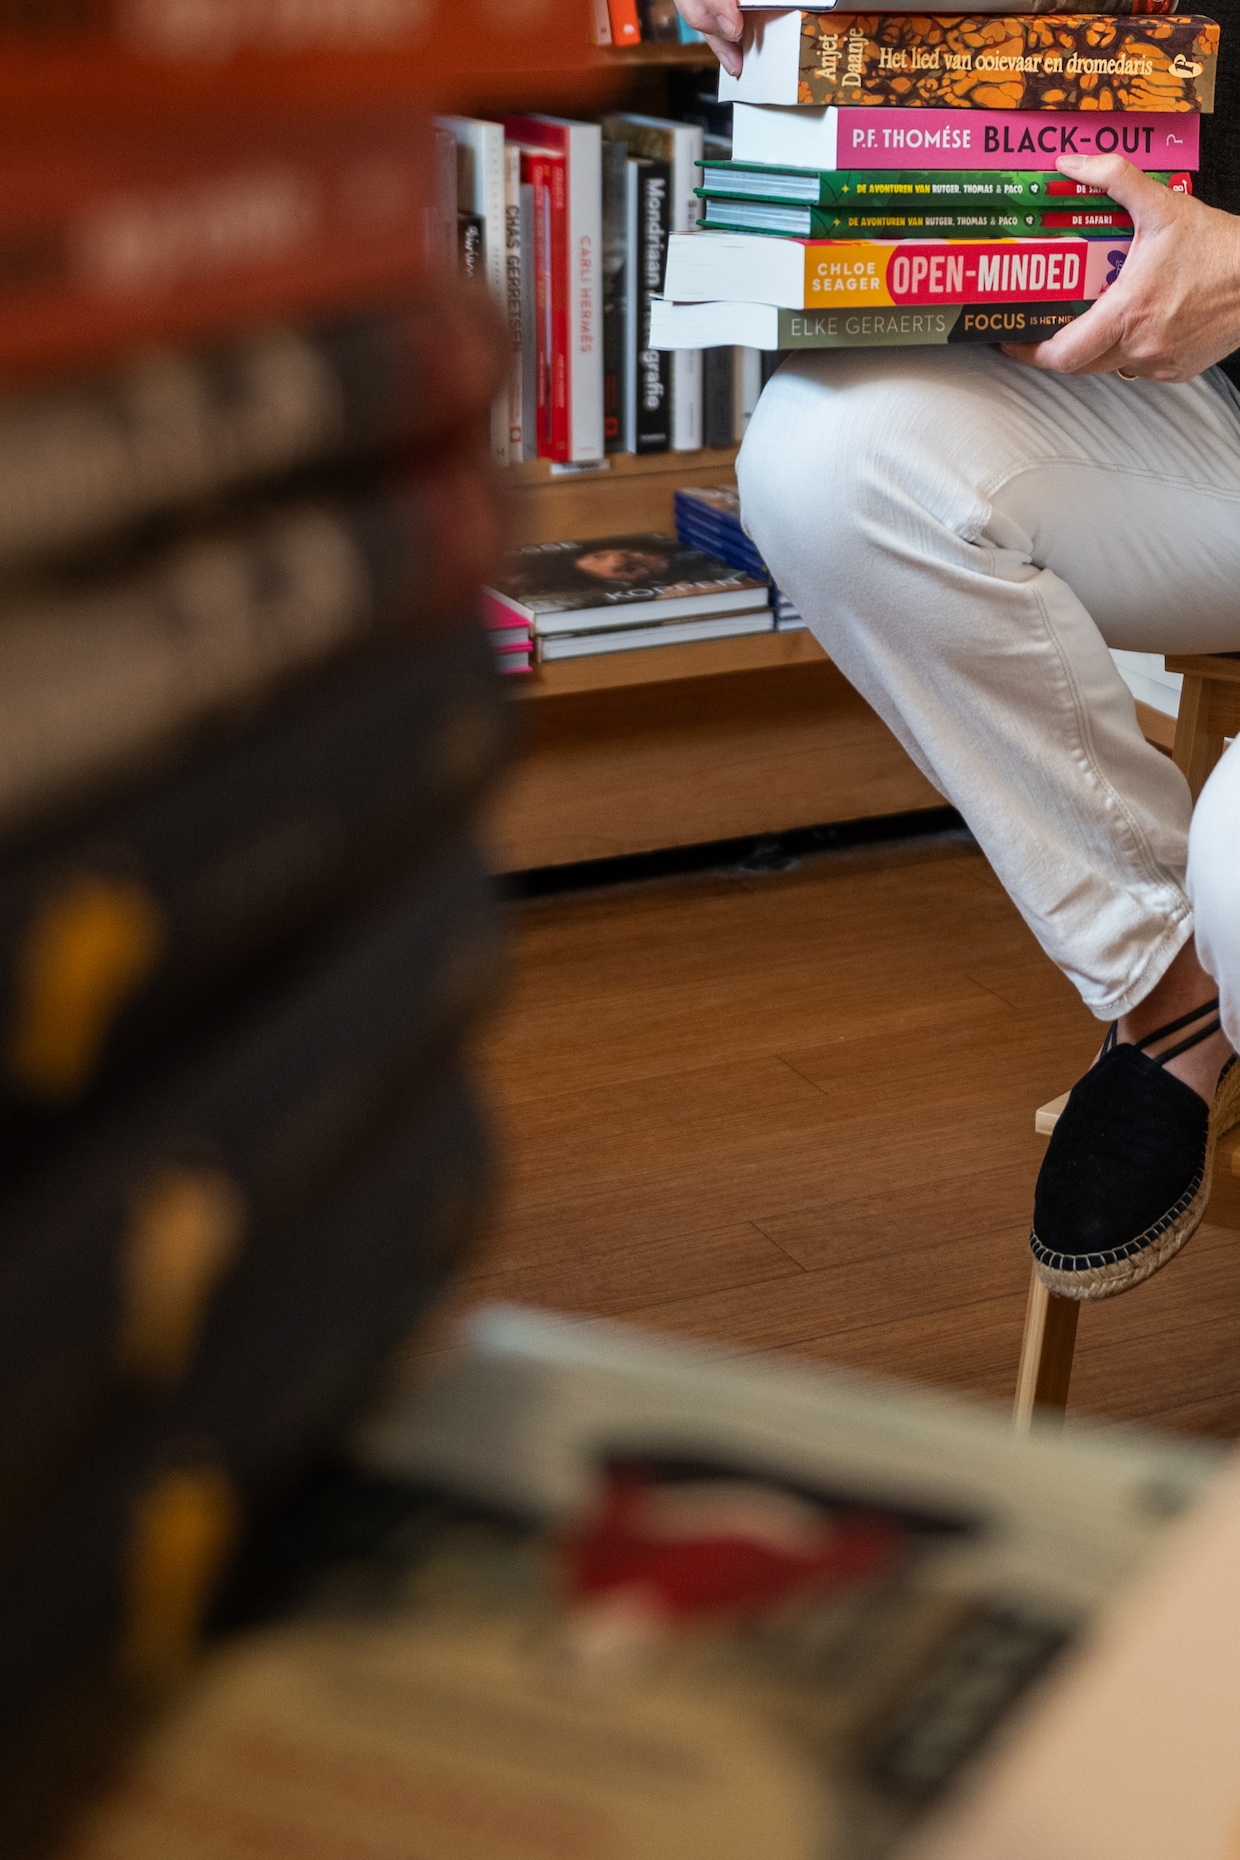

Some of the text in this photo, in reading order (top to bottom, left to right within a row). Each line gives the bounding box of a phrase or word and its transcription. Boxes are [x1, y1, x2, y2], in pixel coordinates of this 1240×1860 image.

[818, 33, 840, 81] Anjet
[842, 27, 864, 87] Daanje
[879, 46, 1153, 76] Het lied van ooievaar en dromedaris
[852, 126, 971, 149] P.F. THOMÉSE
[984, 126, 1155, 154] BLACK-OUT
[857, 184, 1023, 195] DE AVONTUREN VAN RUTGER, THOMAS & PACO
[1076, 184, 1088, 194] DE
[505, 205, 520, 249] CHAS
[645, 178, 666, 285] Mondriaan
[848, 216, 1018, 227] DE AVONTUREN VAN RUTGER, THOMAS & PACO
[1072, 215, 1113, 225] DE SAFARI
[580, 236, 591, 283] CARLI
[817, 263, 876, 276] CHLOE
[812, 278, 880, 292] SEAGER
[893, 254, 1079, 294] OPEN-MINDED
[791, 314, 946, 336] ELKE GERAERTS
[964, 313, 1056, 331] FOCUS IS HET
